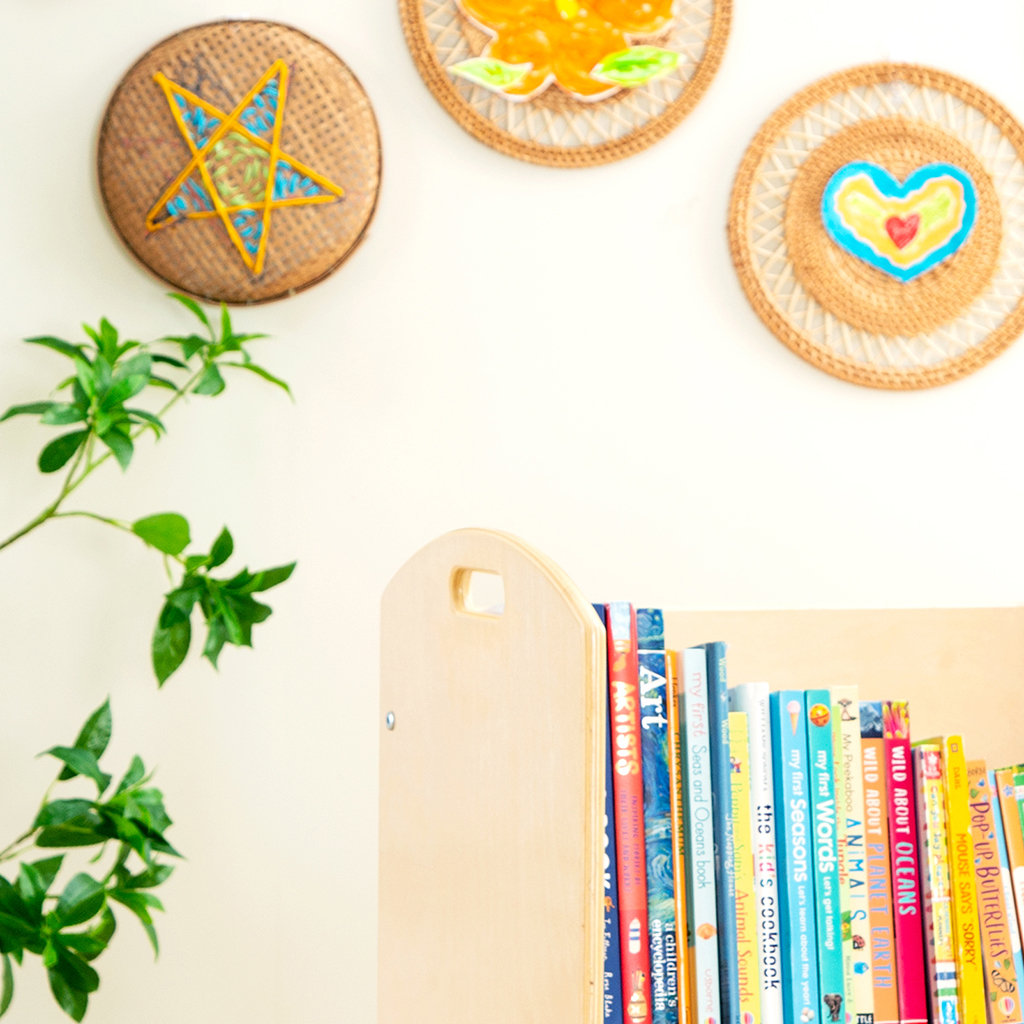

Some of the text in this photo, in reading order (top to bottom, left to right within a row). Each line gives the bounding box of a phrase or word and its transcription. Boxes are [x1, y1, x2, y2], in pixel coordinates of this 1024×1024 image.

[612, 681, 639, 776] ARTISTS
[639, 666, 668, 730] Art
[788, 749, 801, 769] my
[842, 734, 851, 750] My
[689, 673, 711, 888] my first Seas and Oceans book
[792, 772, 803, 796] first
[843, 754, 855, 812] Peekaboo
[791, 798, 808, 883] Seasons
[815, 750, 836, 950] my first Words Let's get talking!
[891, 746, 917, 916] WILD ABOUT OCEANS
[956, 833, 970, 878] MOUSE
[757, 804, 780, 990] the kid's cookbook
[863, 747, 892, 988] WILD ABOUT PLANET EARTH
[958, 882, 972, 914] SAYS
[736, 889, 751, 943] Animal
[651, 919, 667, 1011] encyclopedia
[666, 923, 677, 1008] a children's
[737, 950, 754, 1002] Sounds
[801, 964, 809, 978] the
